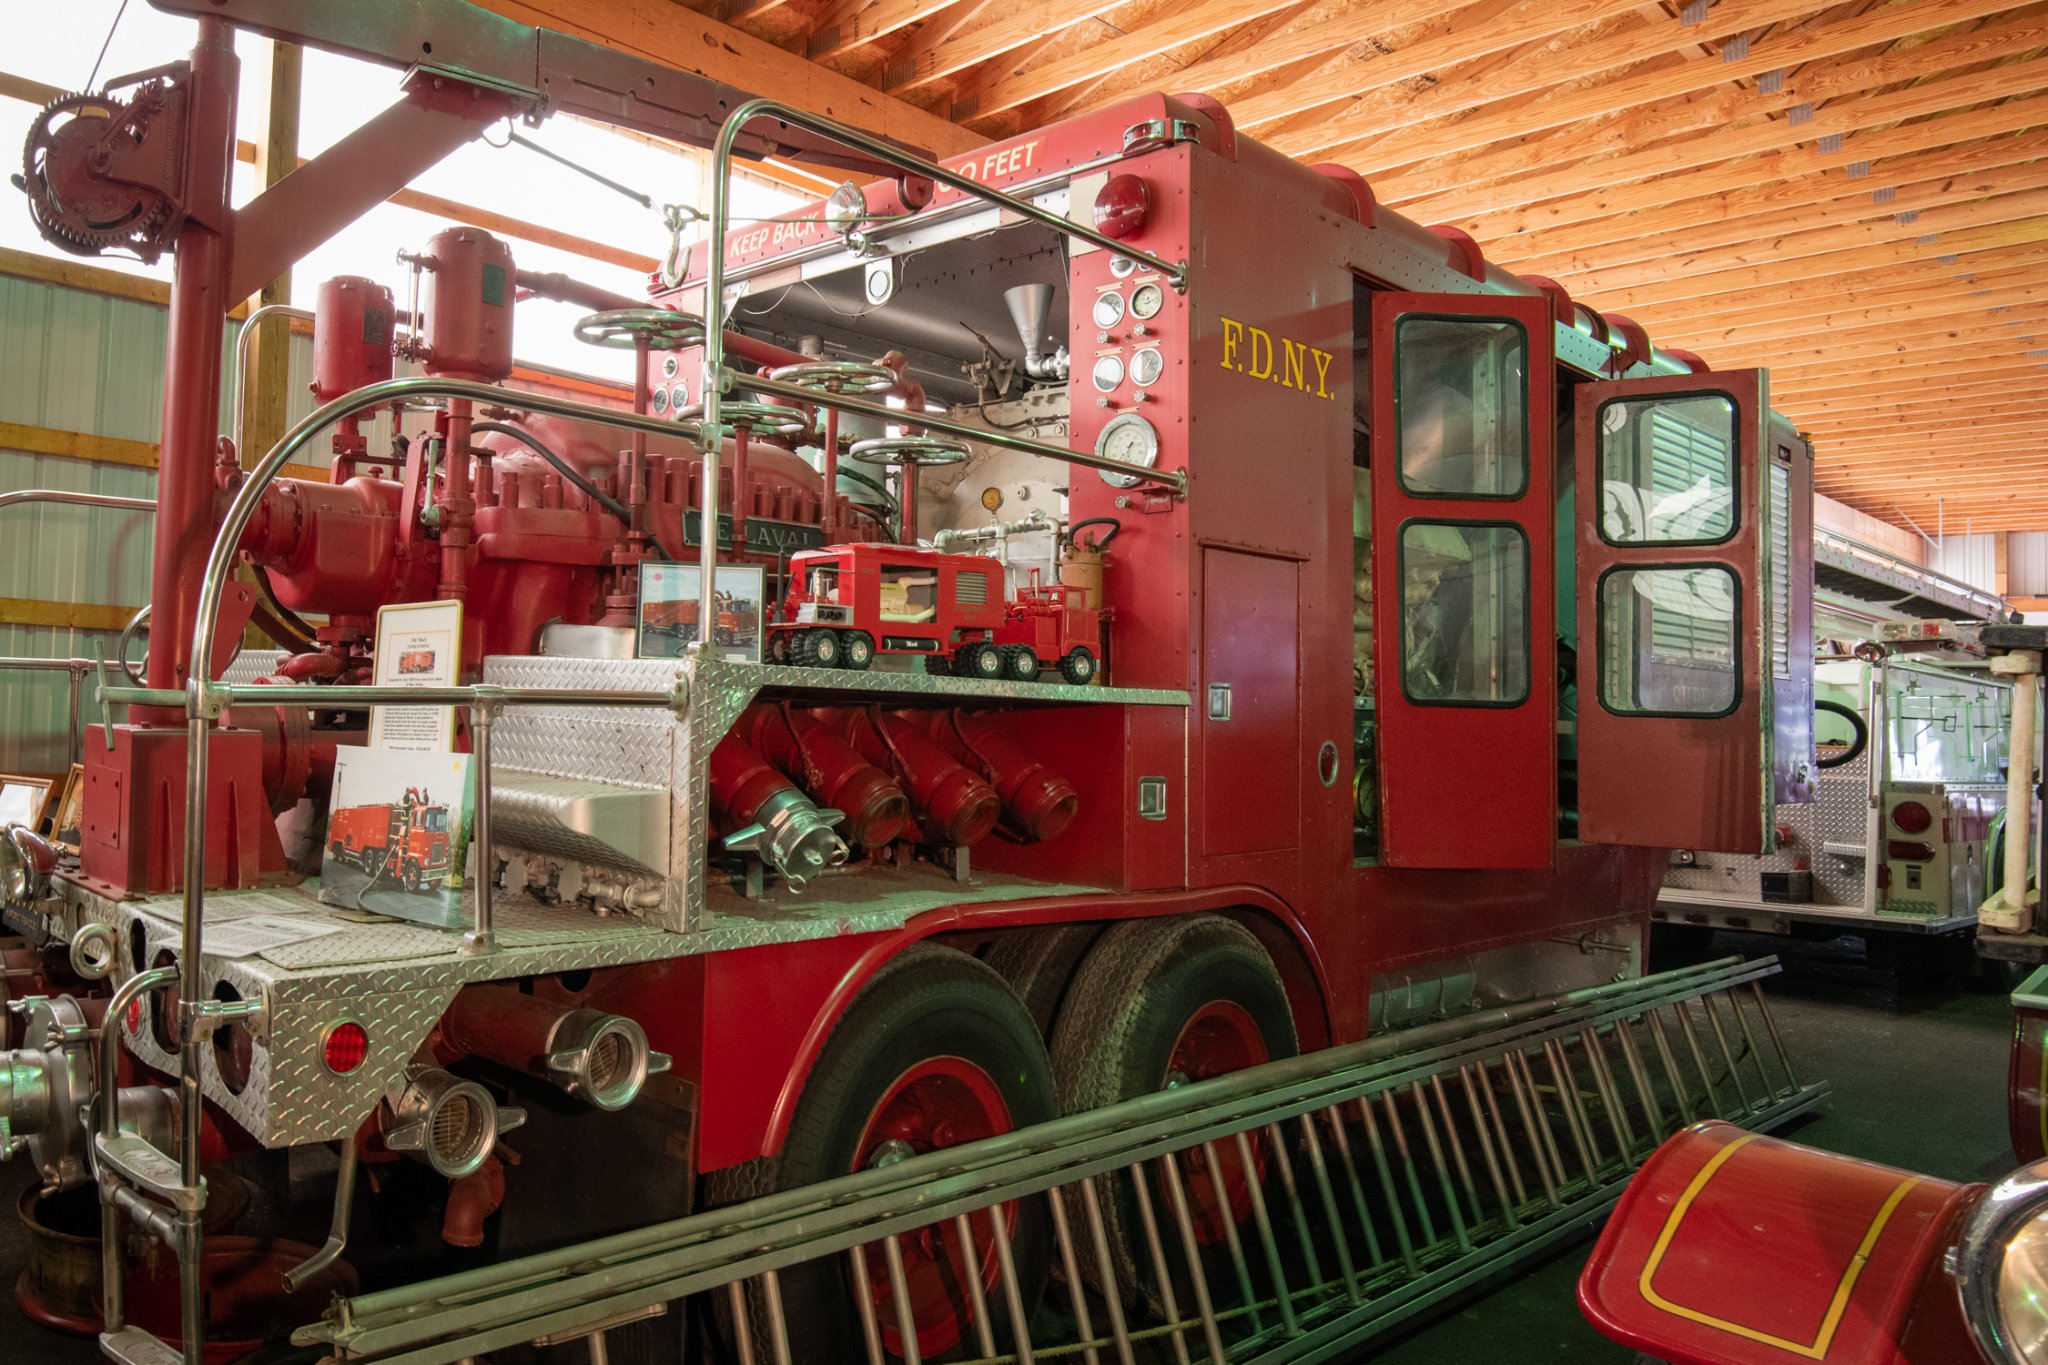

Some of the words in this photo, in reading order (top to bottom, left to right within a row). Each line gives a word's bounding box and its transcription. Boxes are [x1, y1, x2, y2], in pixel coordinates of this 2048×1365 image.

[730, 227, 769, 258] KEEP
[772, 211, 819, 245] BACK
[982, 141, 1038, 180] FEET
